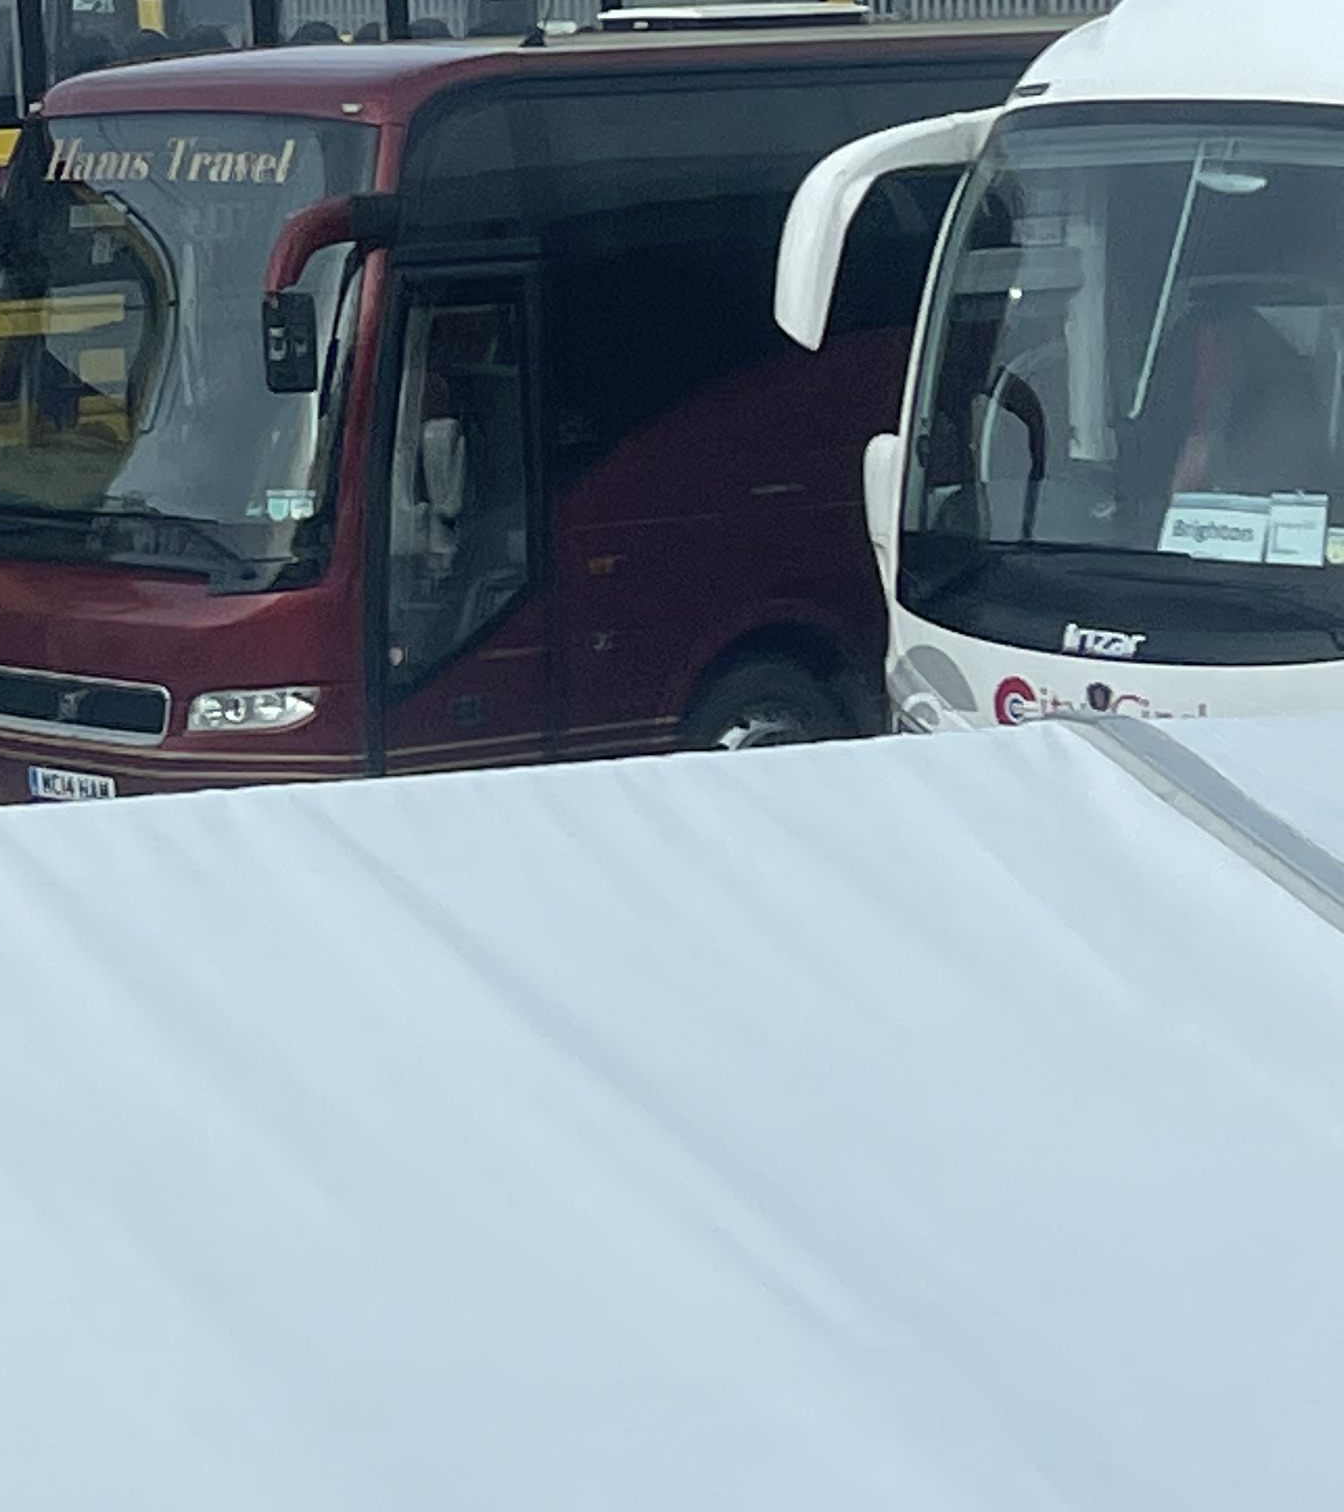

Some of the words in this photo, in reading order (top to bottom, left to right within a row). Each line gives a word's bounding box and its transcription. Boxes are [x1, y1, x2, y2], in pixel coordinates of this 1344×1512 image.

[44, 137, 150, 182] Hams
[168, 137, 295, 184] Travel
[1173, 518, 1254, 543] Brighton
